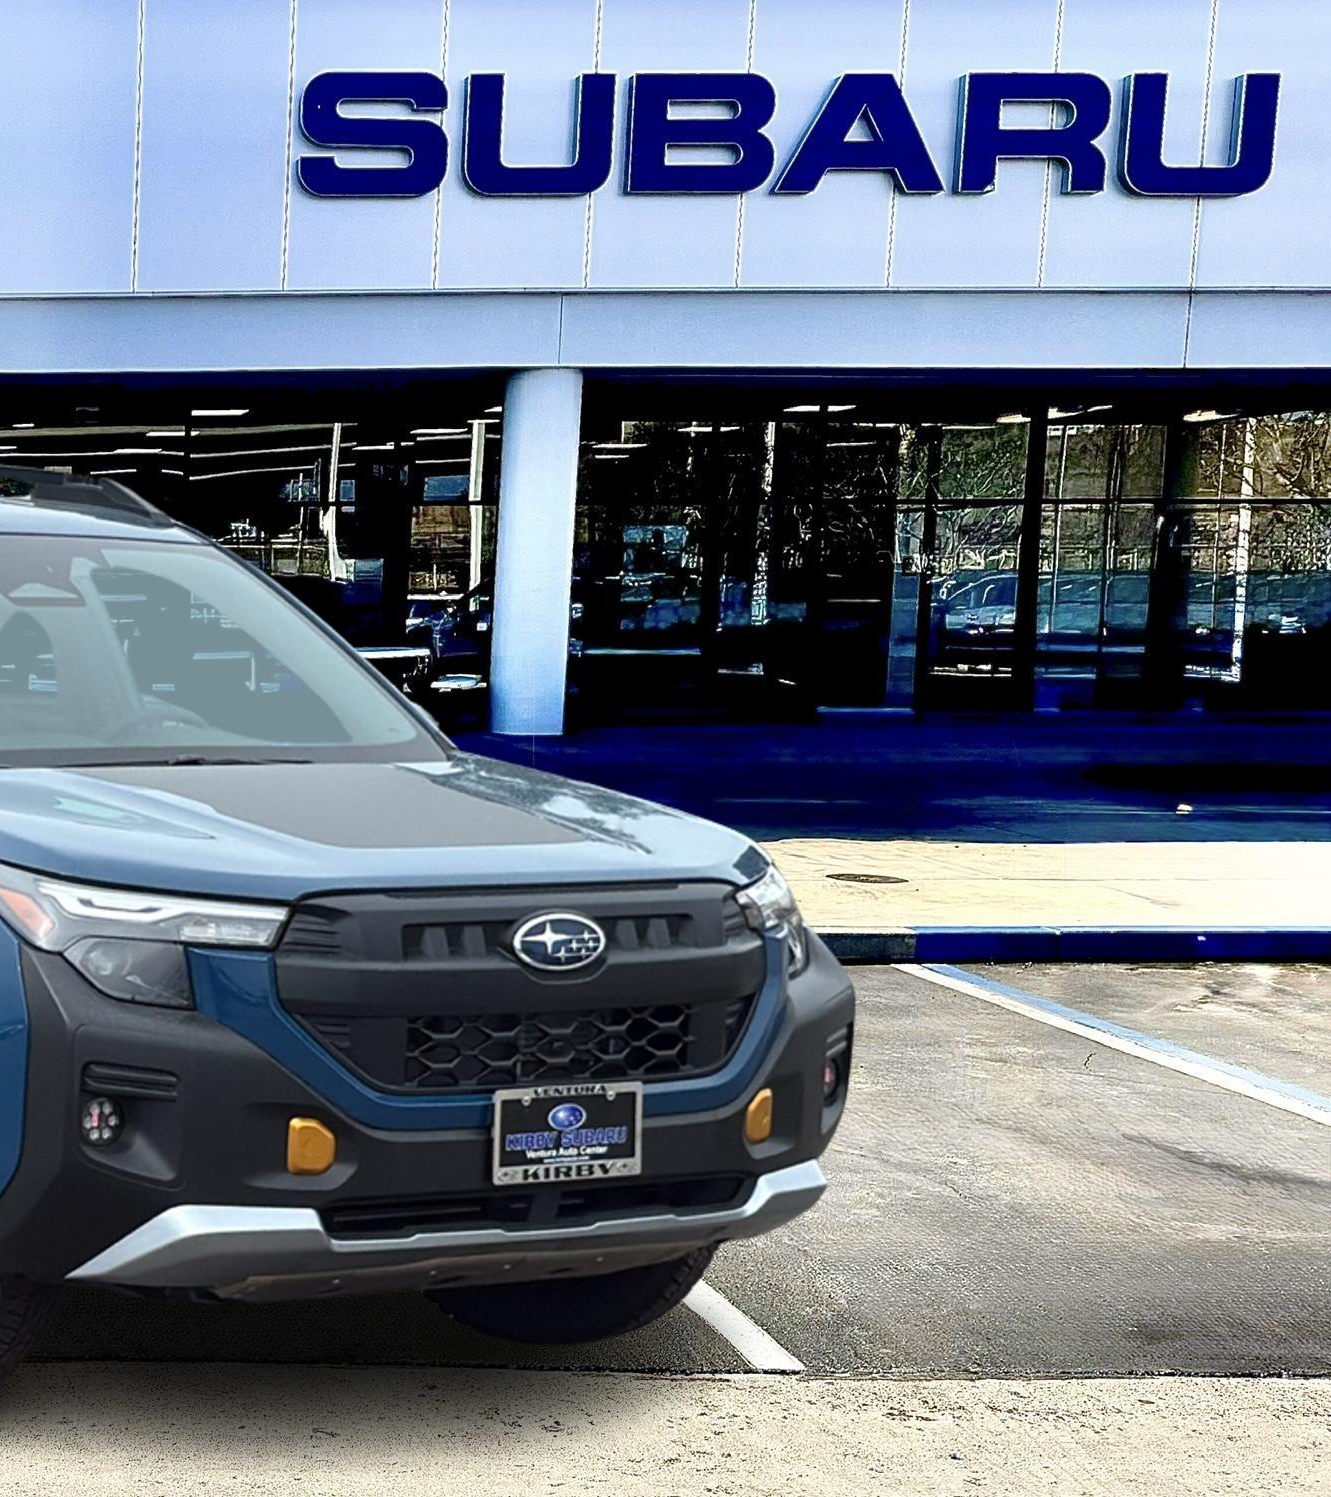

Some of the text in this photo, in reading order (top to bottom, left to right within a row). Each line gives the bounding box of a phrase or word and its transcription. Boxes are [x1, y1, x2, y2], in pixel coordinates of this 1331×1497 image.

[297, 71, 1280, 196] SUBARU
[506, 1126, 627, 1151] KIRBY SUBARU
[525, 1148, 557, 1160] Ventura
[558, 1147, 578, 1156] Auto
[580, 1145, 608, 1155] Center
[523, 1162, 614, 1181] KIRBY
